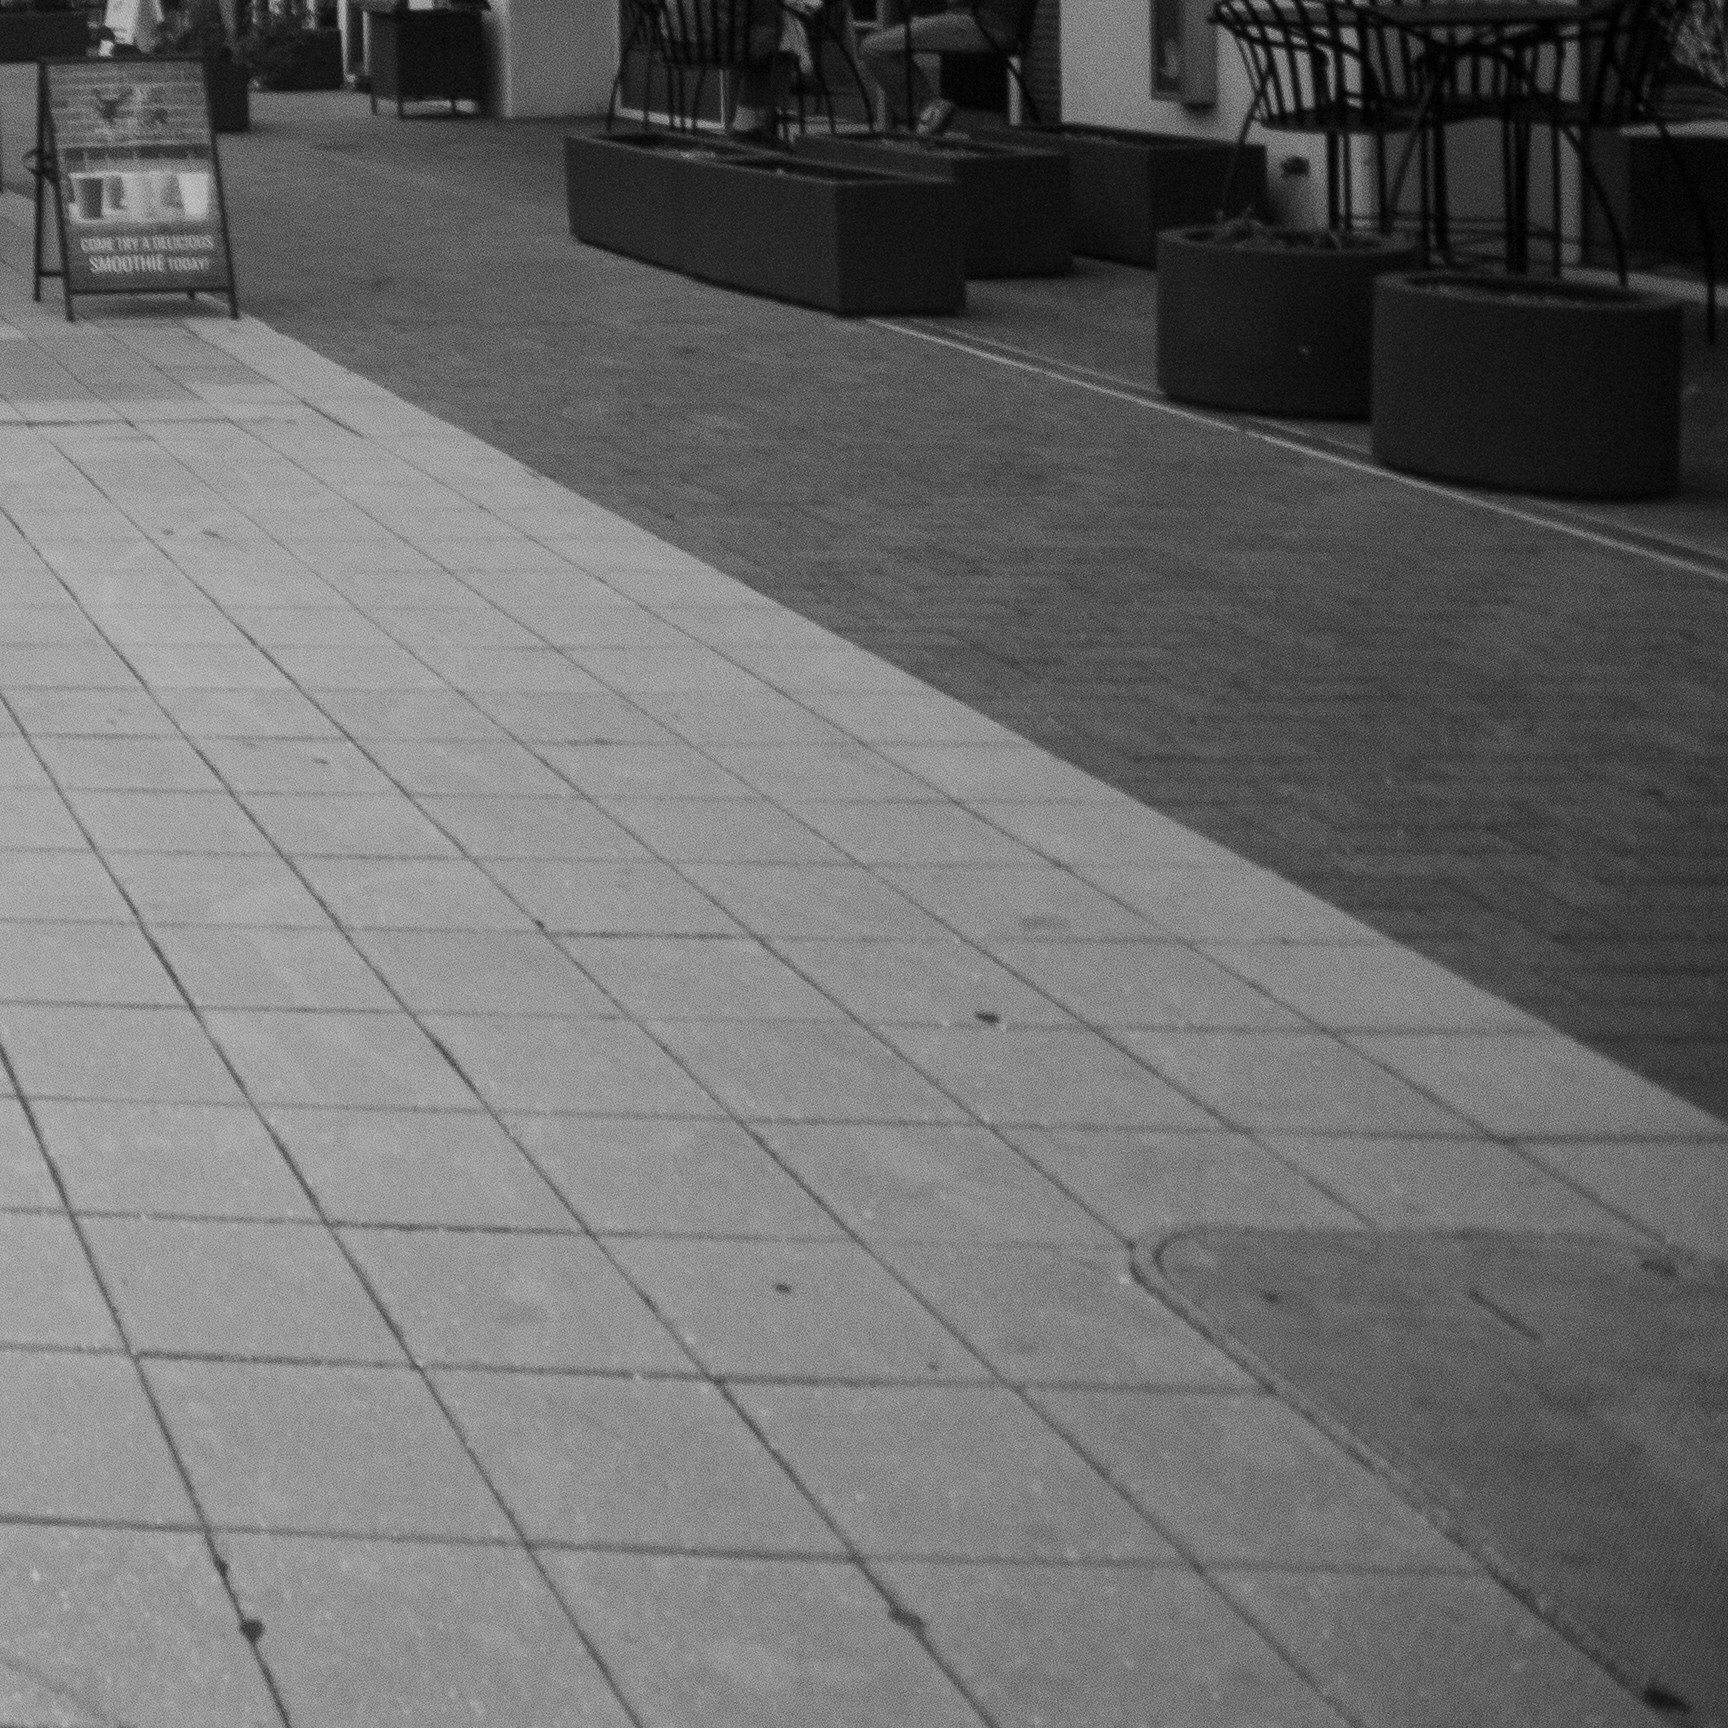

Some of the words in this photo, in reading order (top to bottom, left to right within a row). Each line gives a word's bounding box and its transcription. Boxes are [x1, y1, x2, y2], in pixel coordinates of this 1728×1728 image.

[80, 236, 113, 253] COME
[116, 236, 139, 252] TRY
[152, 234, 215, 251] DELICIOUS
[88, 253, 165, 273] SMOOTHIE
[166, 256, 211, 272] TODAY!
